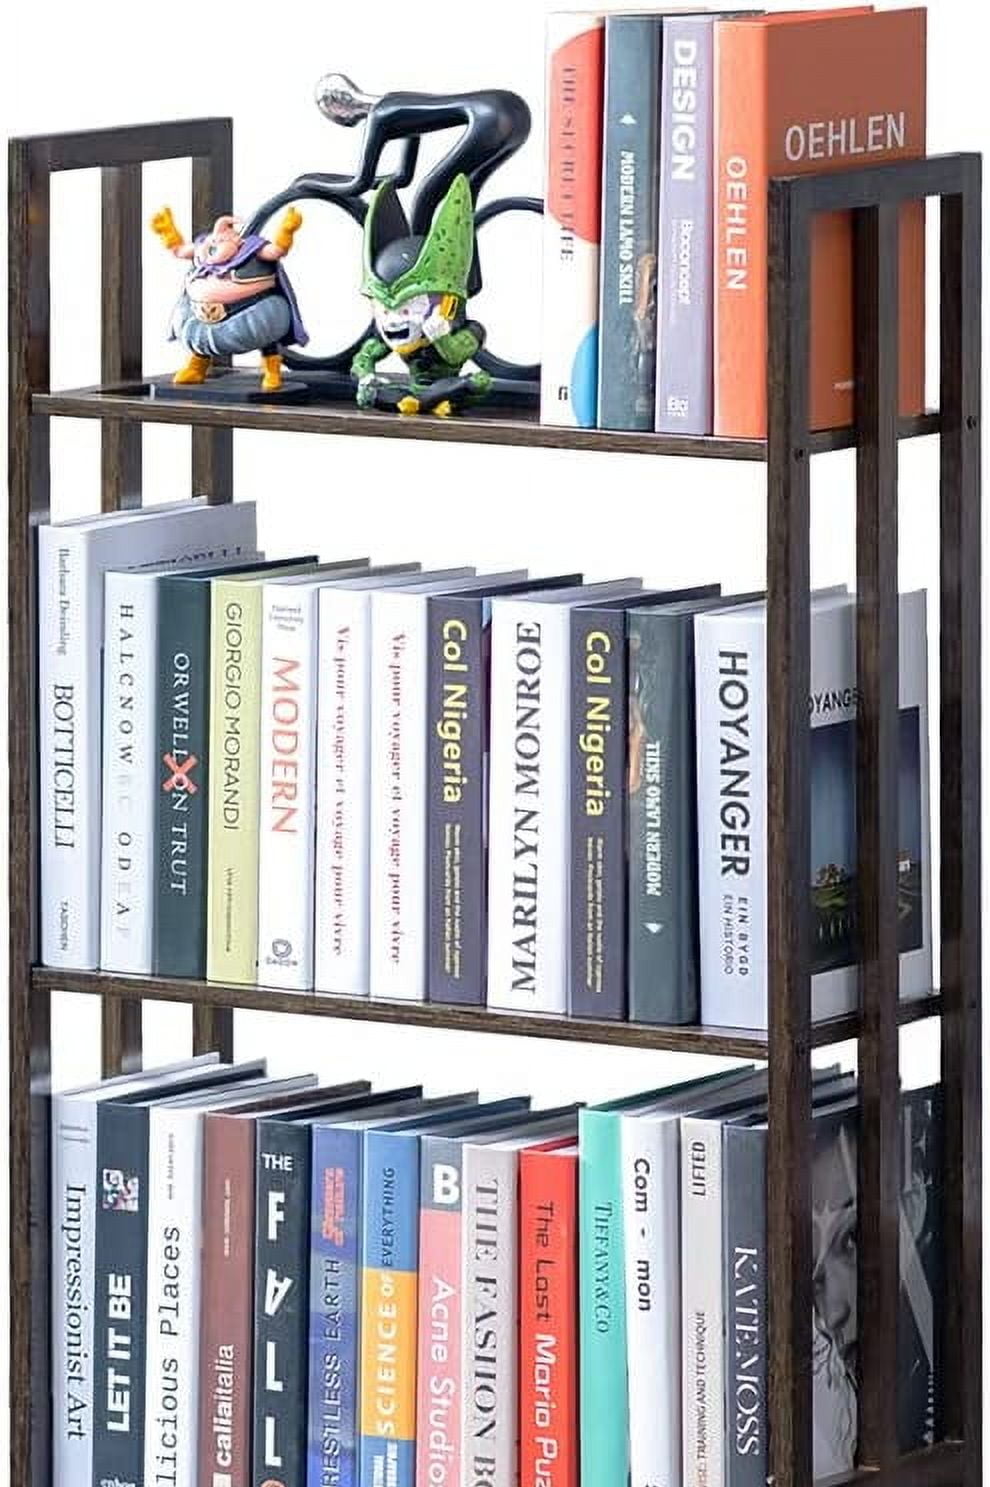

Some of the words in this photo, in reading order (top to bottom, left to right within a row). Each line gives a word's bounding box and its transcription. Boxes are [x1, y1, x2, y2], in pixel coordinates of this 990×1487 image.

[671, 39, 697, 181] DESIGN
[785, 112, 905, 161] OEHLEN
[726, 156, 748, 290] OEHLEN
[224, 602, 242, 709] GIORGIO
[443, 620, 468, 672] Col
[586, 630, 611, 684] Col
[172, 652, 190, 766] ORWELL
[271, 657, 300, 833] MODERN
[436, 684, 468, 802] Nigeria
[513, 621, 541, 797] MONROE
[53, 683, 75, 848] BOTTICELLI
[171, 773, 188, 811] ON
[223, 716, 241, 830] MORANDI
[579, 696, 610, 817] Nigeria
[719, 650, 751, 877] HOYANGER
[170, 822, 188, 896] TRUT
[512, 808, 538, 995] MARILYN
[261, 1152, 294, 1172] THE
[432, 1163, 460, 1205] B
[633, 1158, 651, 1213] Com
[692, 1142, 707, 1196] LIFTED
[381, 1167, 396, 1267] EVERYTHING
[475, 1179, 499, 1260] THE
[535, 1200, 555, 1248] The
[61, 1183, 87, 1383] Impressionist
[107, 1273, 132, 1320] BE
[158, 1226, 182, 1335] Places
[321, 1259, 342, 1340] EARTH
[431, 1276, 454, 1360] Acne
[535, 1259, 554, 1322] Last
[636, 1259, 653, 1312] mon
[734, 1245, 761, 1346] KATE
[107, 1327, 130, 1359] IT
[376, 1303, 394, 1434] SCIENCE
[534, 1332, 557, 1427] Mario
[67, 1392, 89, 1441] Art
[106, 1368, 130, 1432] LET
[735, 1351, 761, 1456] MOSS
